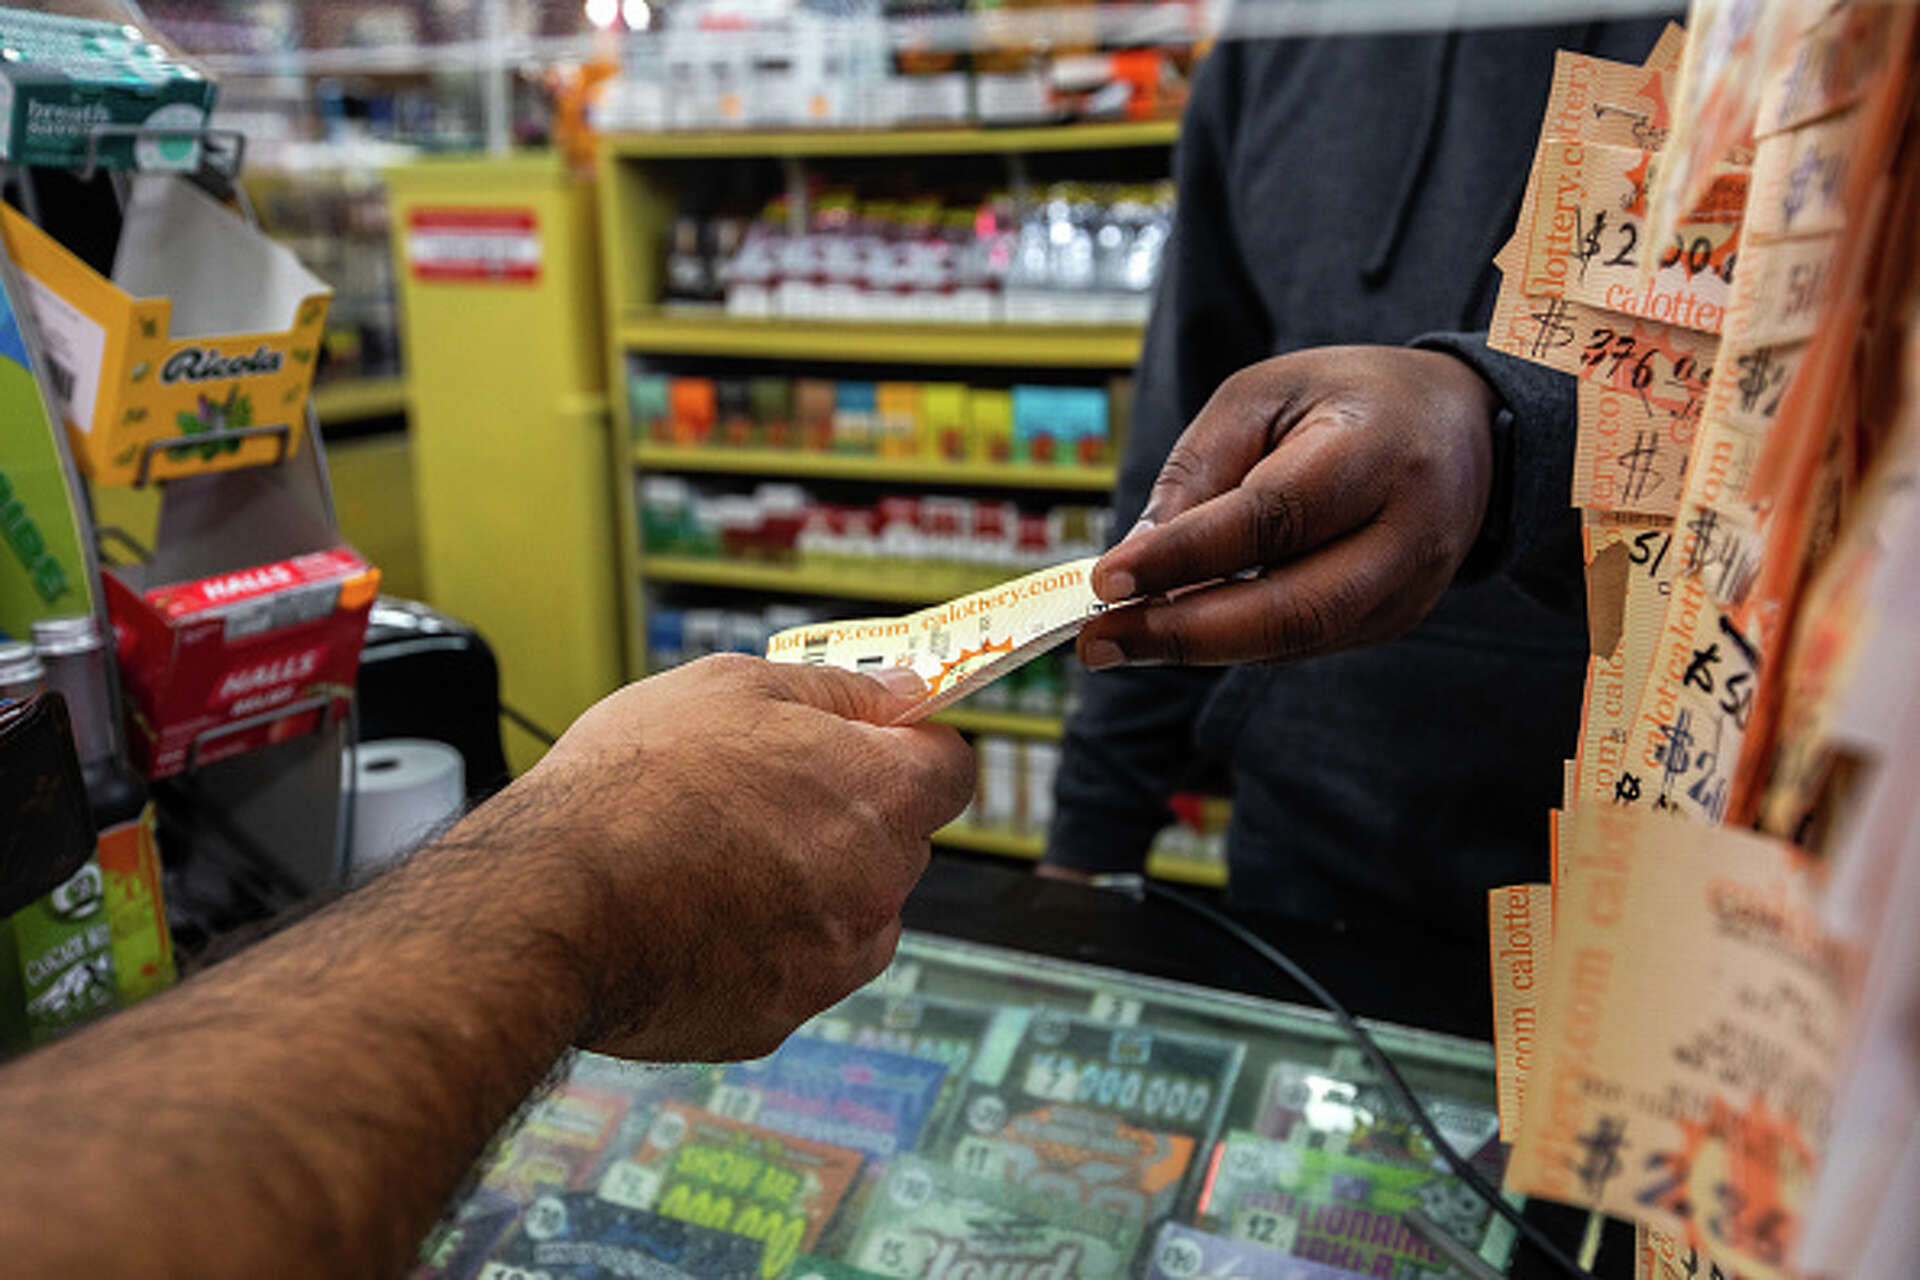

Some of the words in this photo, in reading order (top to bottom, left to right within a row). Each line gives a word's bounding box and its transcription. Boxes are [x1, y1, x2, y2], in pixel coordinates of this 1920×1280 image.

[160, 348, 284, 385] Ricola
[203, 565, 293, 600] HALLS
[219, 650, 318, 699] HALLS
